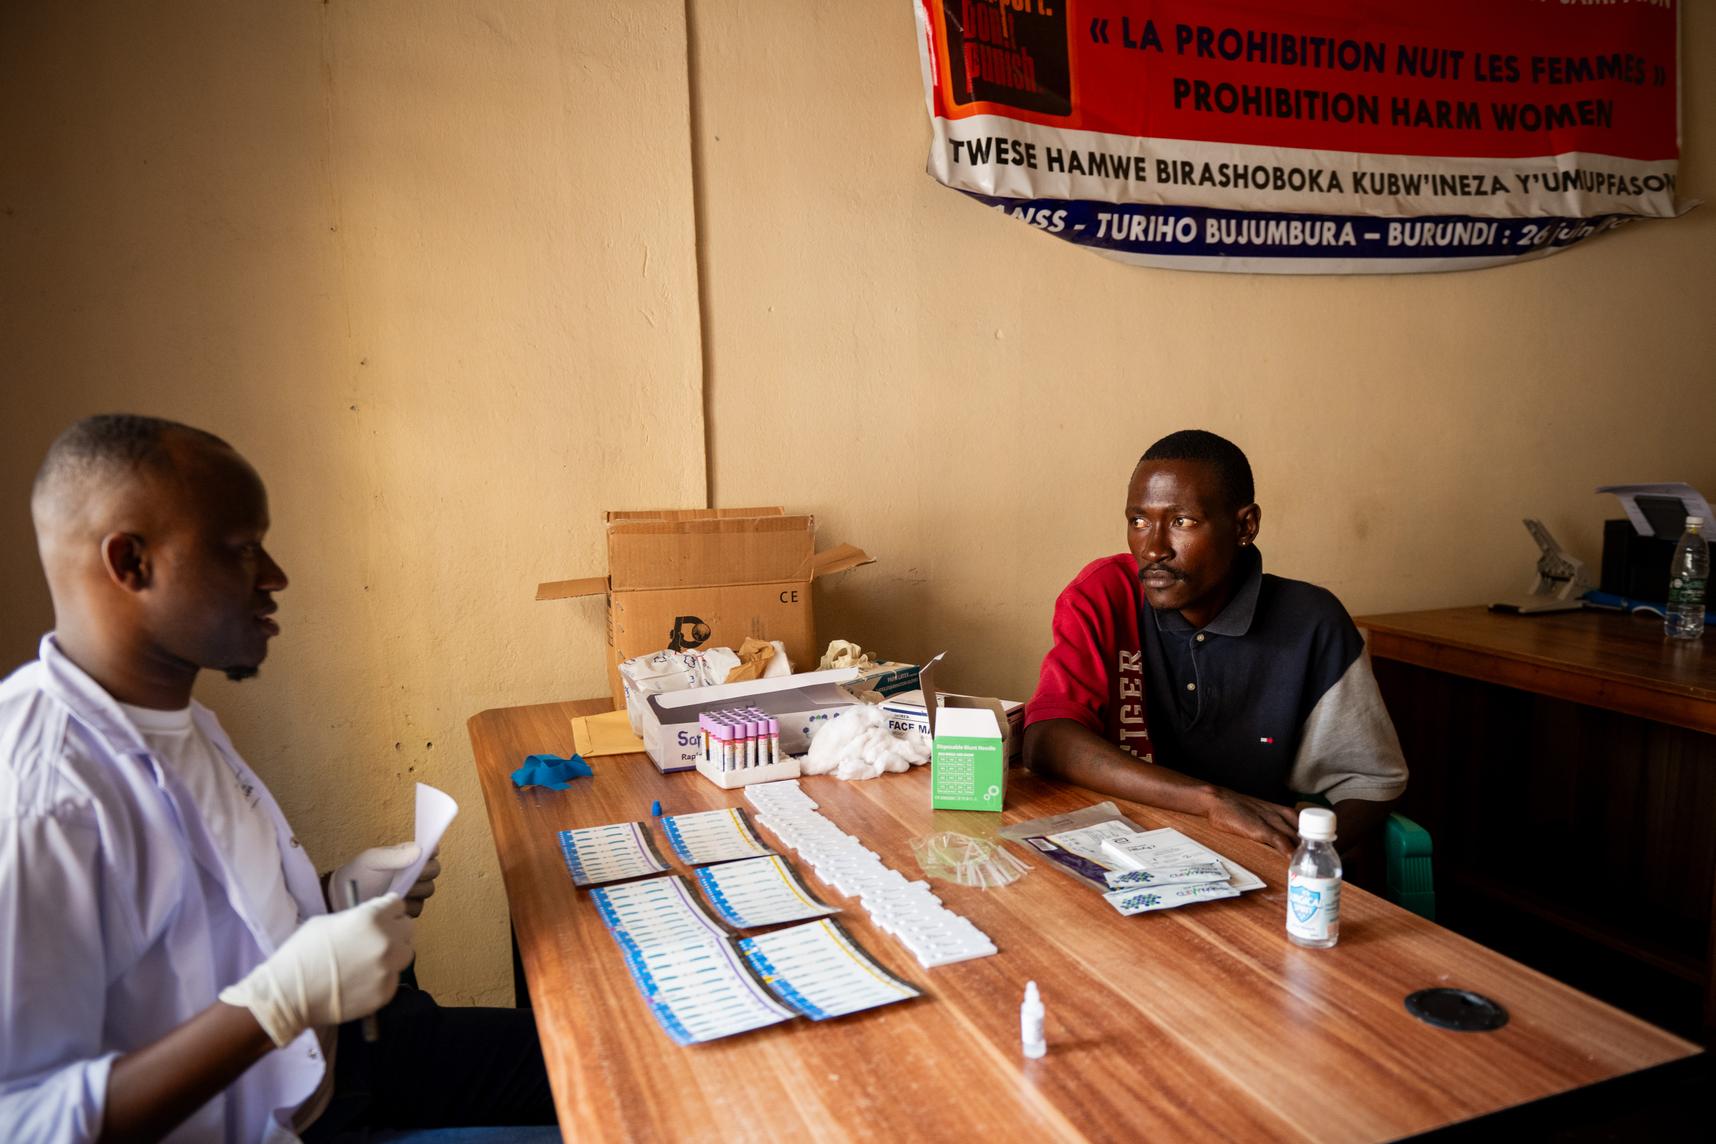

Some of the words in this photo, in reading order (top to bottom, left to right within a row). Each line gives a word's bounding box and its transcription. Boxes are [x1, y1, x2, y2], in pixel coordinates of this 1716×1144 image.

[1122, 16, 1164, 53] LA
[1176, 24, 1386, 73] PROHIBITION
[1397, 46, 1465, 80] NUIT
[1474, 53, 1520, 83] LES
[1531, 53, 1645, 86] FEMMES
[1173, 78, 1379, 124] PROHIBITION
[1391, 97, 1482, 130] HARM
[1491, 97, 1614, 133] WOMEN
[948, 137, 1037, 170] TWESE
[1046, 147, 1146, 182] HAMWE
[1156, 159, 1343, 193] BIRASHOBOKA
[1353, 171, 1510, 197] KUBW'INEZA
[1097, 212, 1197, 243] TURIHO
[1205, 218, 1357, 247] BUJUMBURA
[1387, 221, 1495, 247] BURUNDI
[1517, 224, 1551, 246] 26
[779, 590, 799, 604] CE
